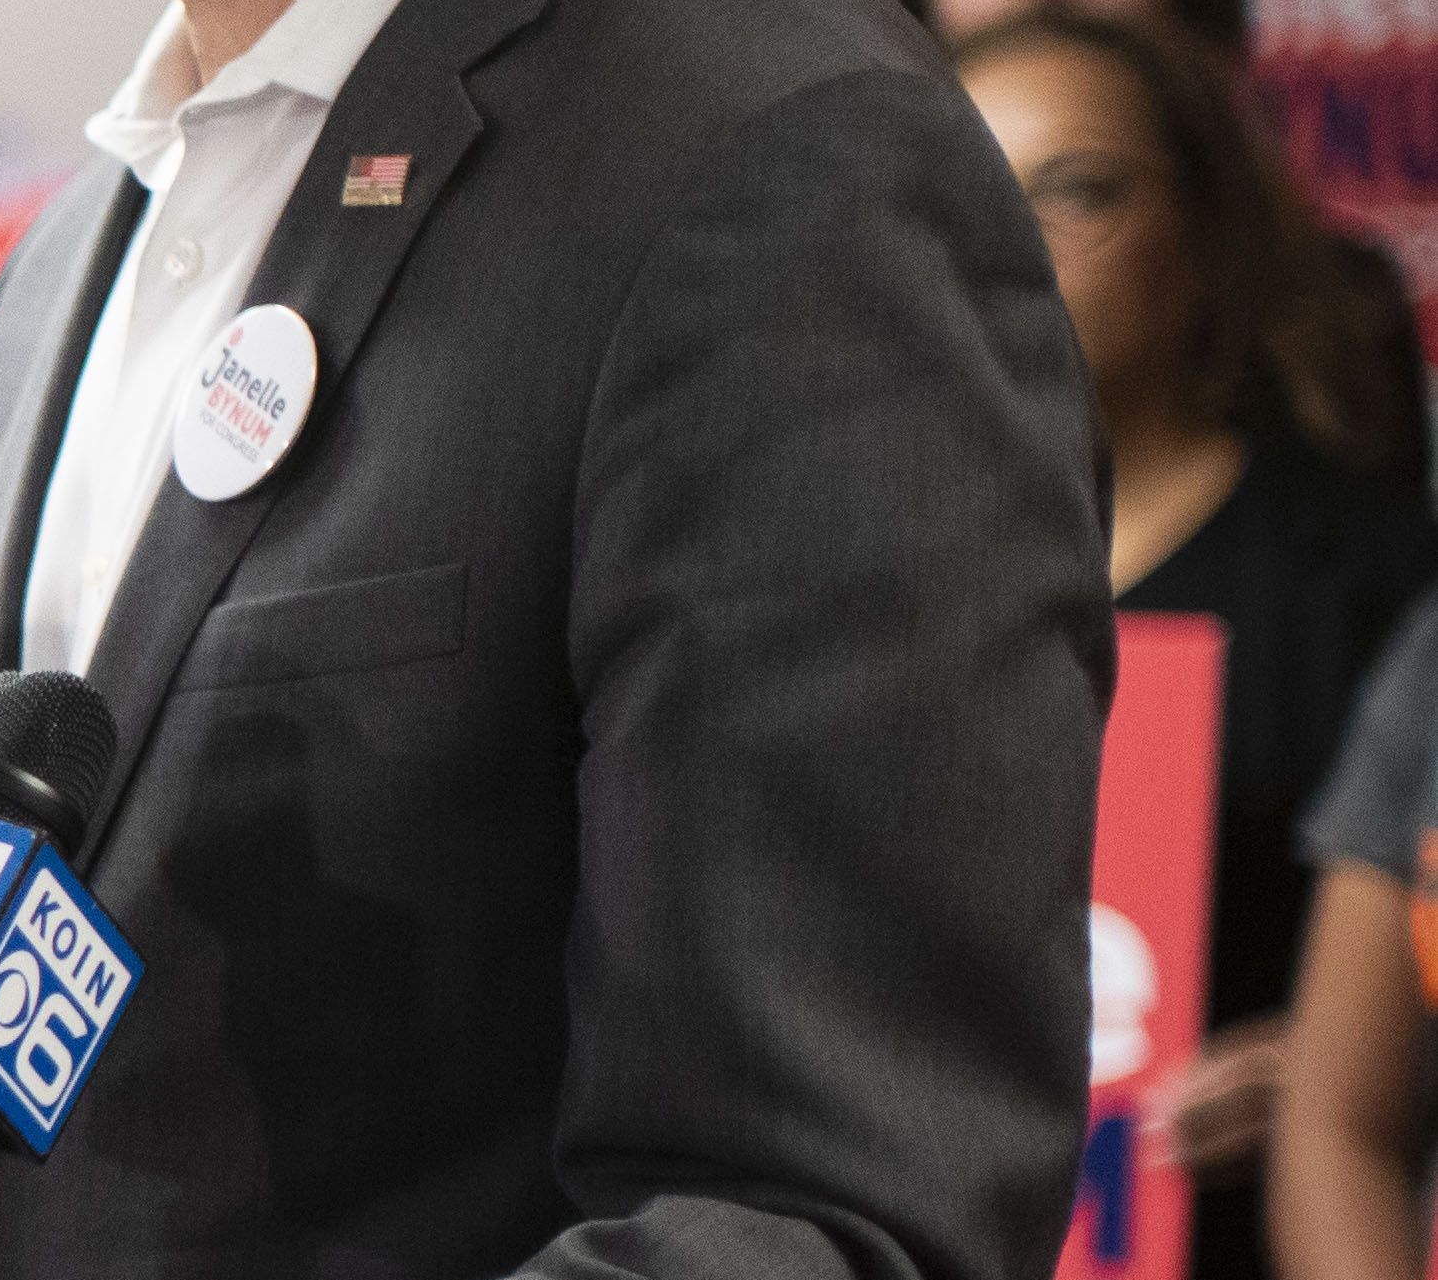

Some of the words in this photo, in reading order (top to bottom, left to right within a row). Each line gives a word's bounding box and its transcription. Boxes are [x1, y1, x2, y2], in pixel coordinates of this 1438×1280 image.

[201, 345, 287, 421] Janelle
[207, 382, 274, 448] BYNUM
[28, 890, 117, 1010] KOIN
[14, 992, 87, 1108] 6
